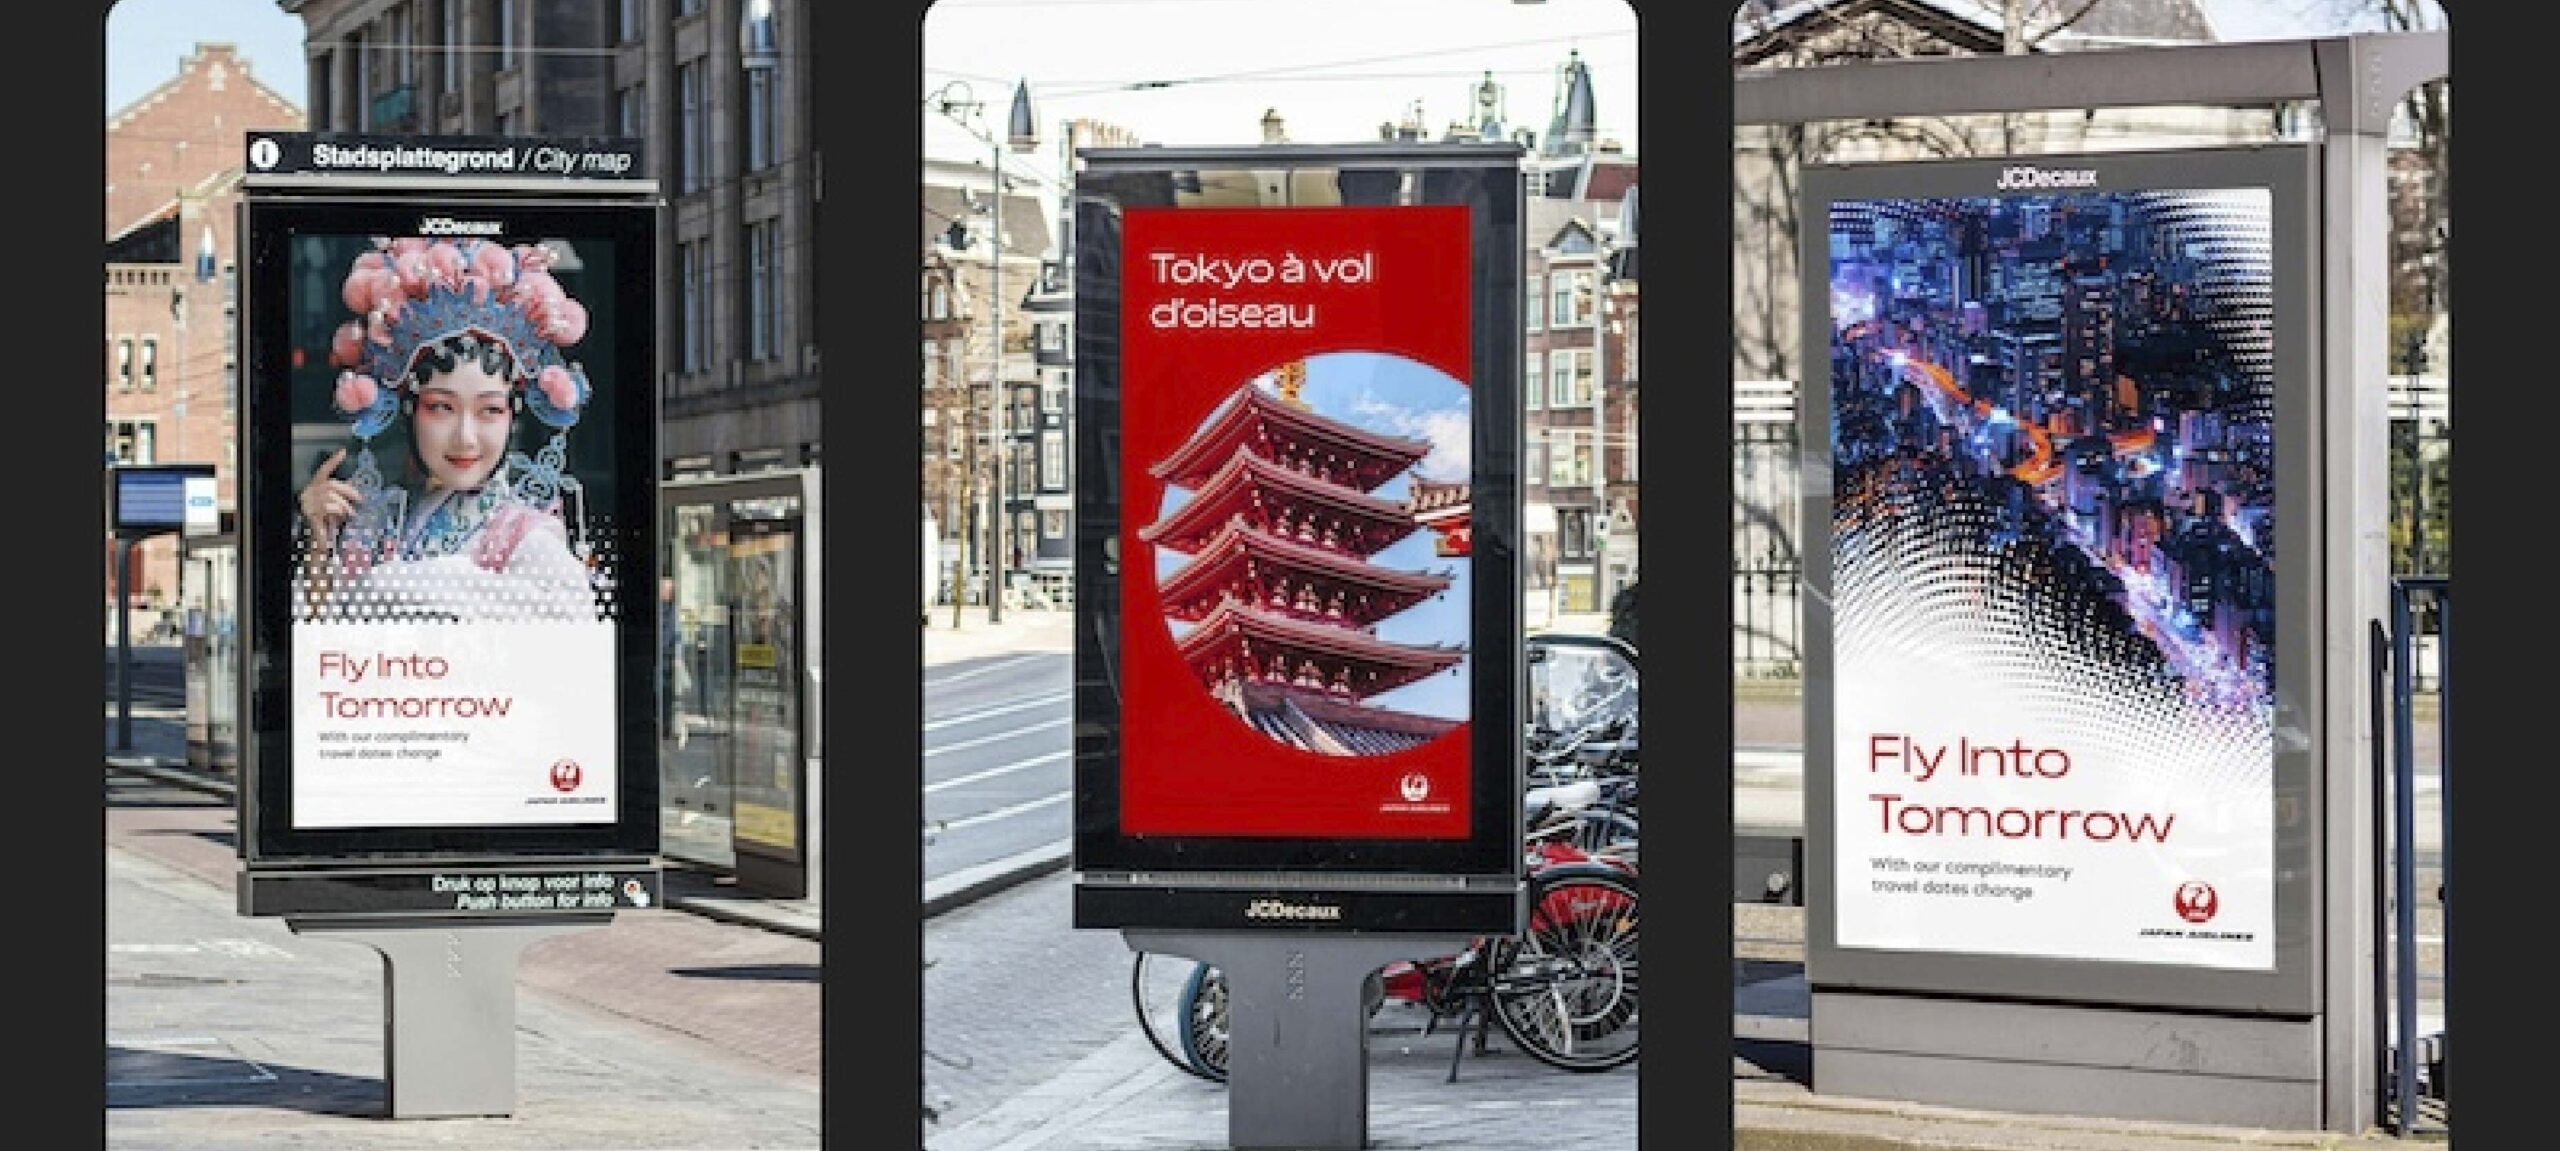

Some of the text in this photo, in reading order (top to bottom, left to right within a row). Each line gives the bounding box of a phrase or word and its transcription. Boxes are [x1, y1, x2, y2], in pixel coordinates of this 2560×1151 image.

[313, 145, 513, 172] Stadsplattegrond
[534, 147, 578, 173] City
[582, 152, 631, 173] map
[1997, 166, 2097, 190] JCDecaux
[1150, 251, 1374, 289] Tokyo à vol
[319, 652, 449, 682] Fly Into
[319, 690, 512, 718] Tomorrow
[1870, 735, 2071, 782] Fly Into
[1869, 794, 2175, 843] Tomorrow
[1870, 857, 2074, 882] With our complimentary
[432, 876, 470, 891] Druk
[1872, 880, 2034, 903] travel dates change
[457, 893, 496, 909] Push
[502, 893, 554, 909] button
[1245, 899, 1341, 919] JCDecaux
